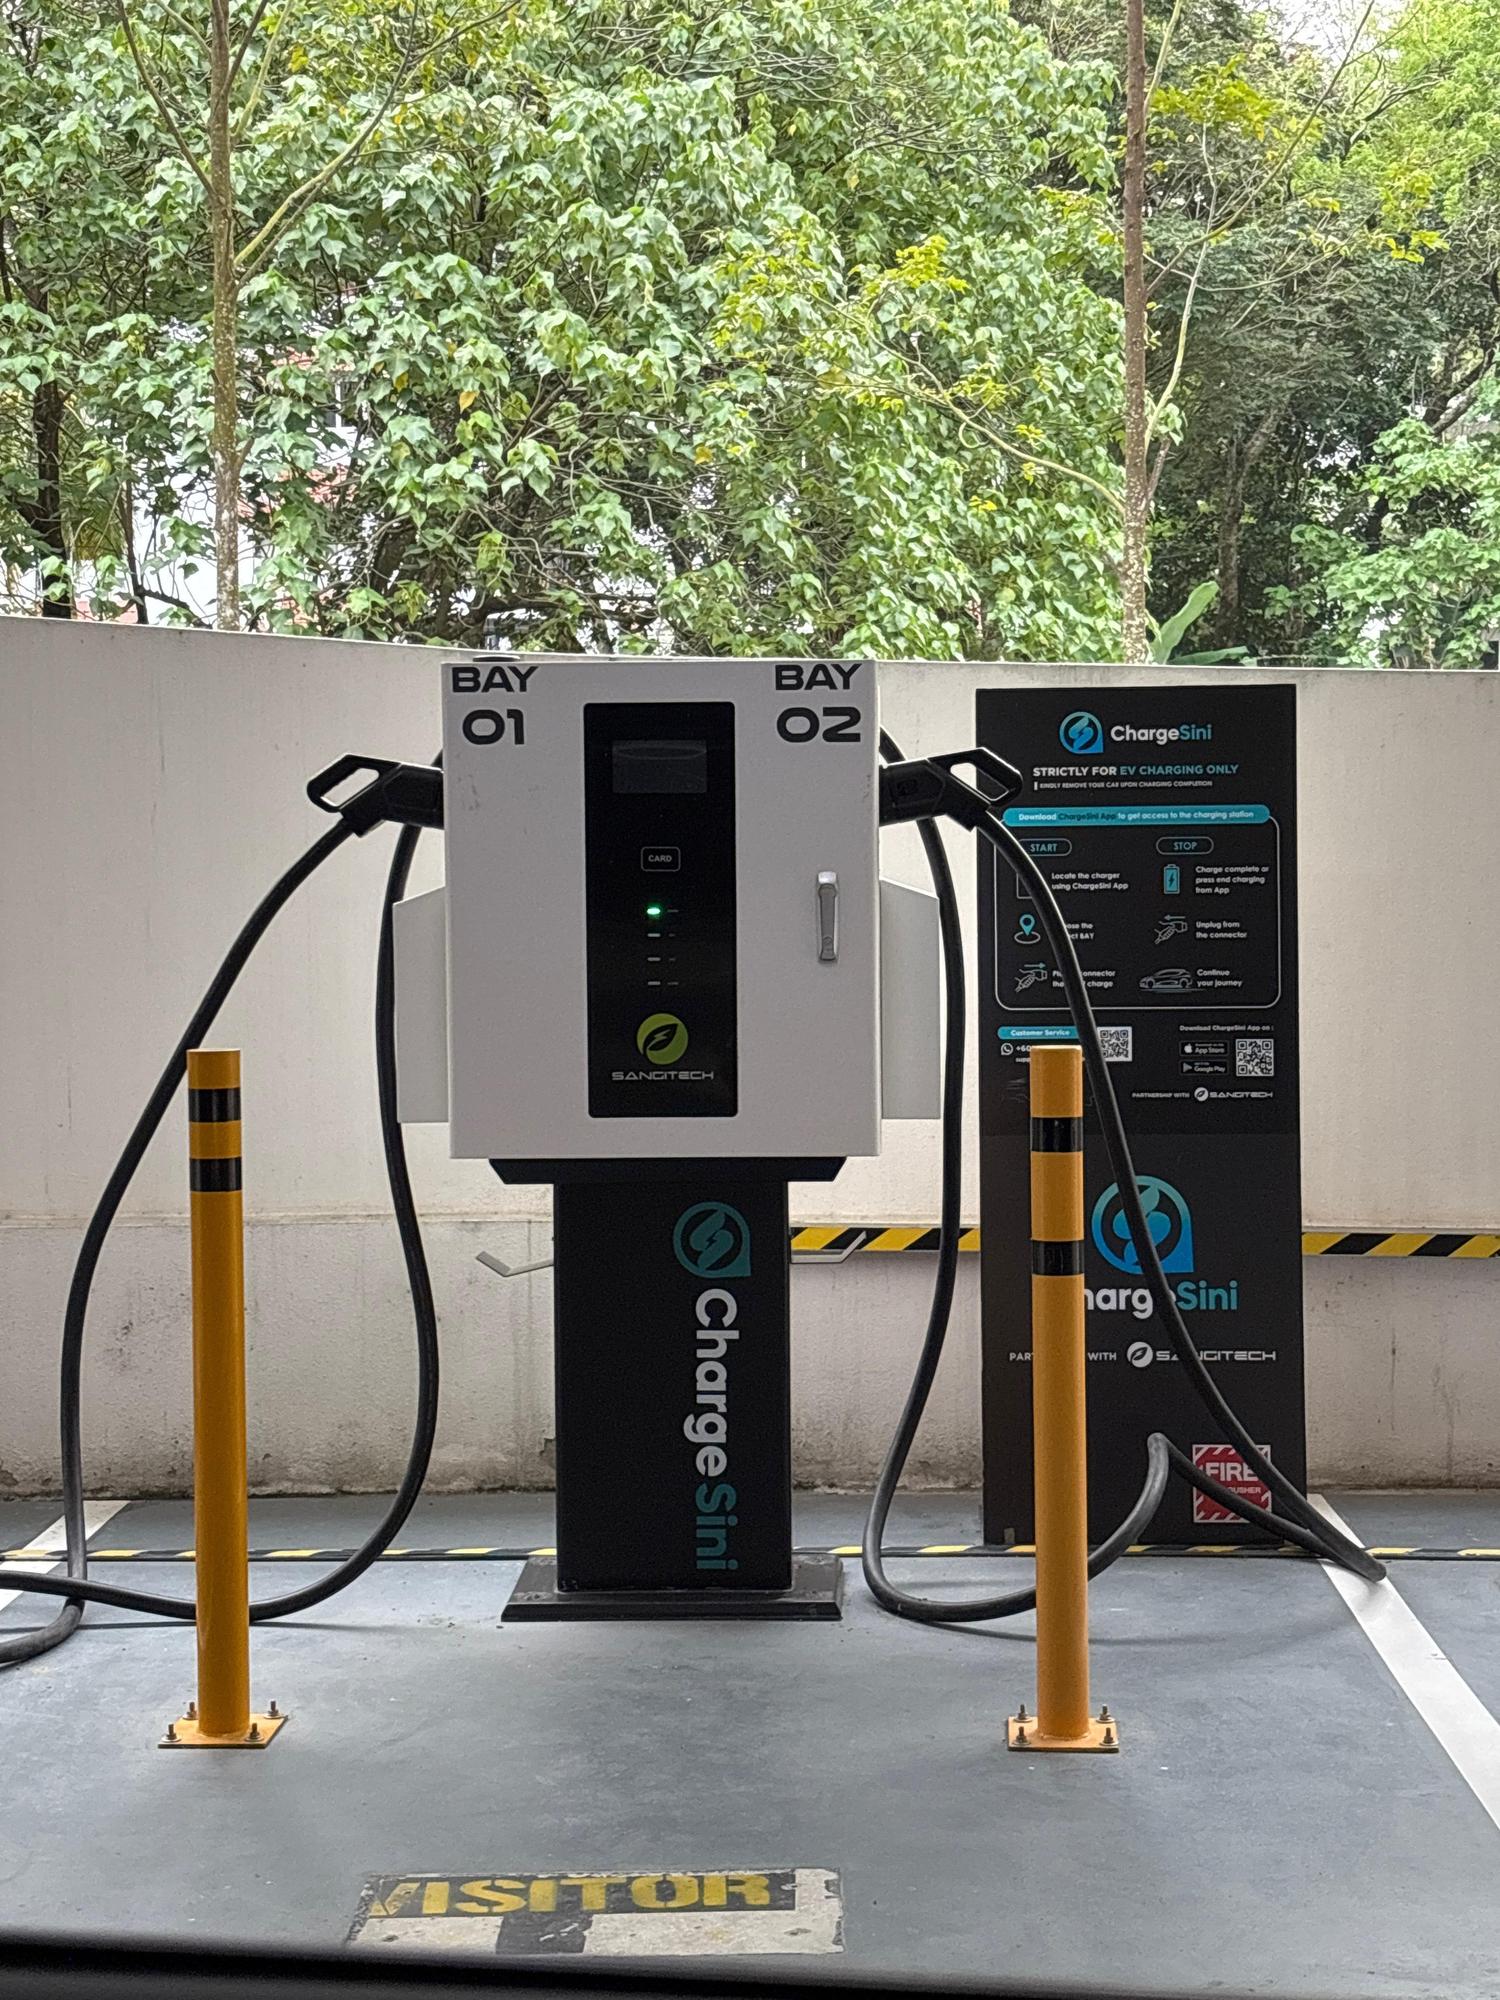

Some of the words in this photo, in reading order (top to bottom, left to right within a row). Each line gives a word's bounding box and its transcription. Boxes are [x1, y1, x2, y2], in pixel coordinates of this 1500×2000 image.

[451, 665, 539, 693] BAY
[775, 663, 862, 691] BAY
[462, 709, 525, 745] 01
[776, 706, 862, 743] 02
[1110, 723, 1212, 745] ChargeSini
[1032, 767, 1089, 777] STRICTLY
[1092, 766, 1117, 776] FOR
[1119, 766, 1136, 775] EV
[1139, 765, 1204, 775] CHARGING
[1206, 764, 1239, 774] ONLY
[1018, 813, 1057, 821] Download
[1058, 813, 1099, 821] ChargeSini
[1101, 813, 1116, 821] App
[1127, 813, 1140, 821] get
[1193, 811, 1227, 820] charging
[1030, 843, 1058, 852] START
[1173, 841, 1198, 851] STOP
[648, 854, 673, 863] CARD
[1195, 866, 1223, 874] Charge
[1224, 865, 1260, 874] complete
[1091, 872, 1120, 881] charger
[1232, 876, 1266, 884] charging
[1051, 882, 1071, 891] using
[1072, 882, 1112, 891] ChargeSini
[1113, 882, 1129, 891] App
[1195, 886, 1213, 894] from
[1214, 886, 1230, 894] App
[1196, 921, 1222, 930] Unplug
[1087, 980, 1114, 989] charge
[1215, 979, 1243, 988] journey
[1087, 1351, 1117, 1361] WITH
[683, 1288, 740, 1570] ChargeSini
[1205, 1462, 1259, 1481] FIRE
